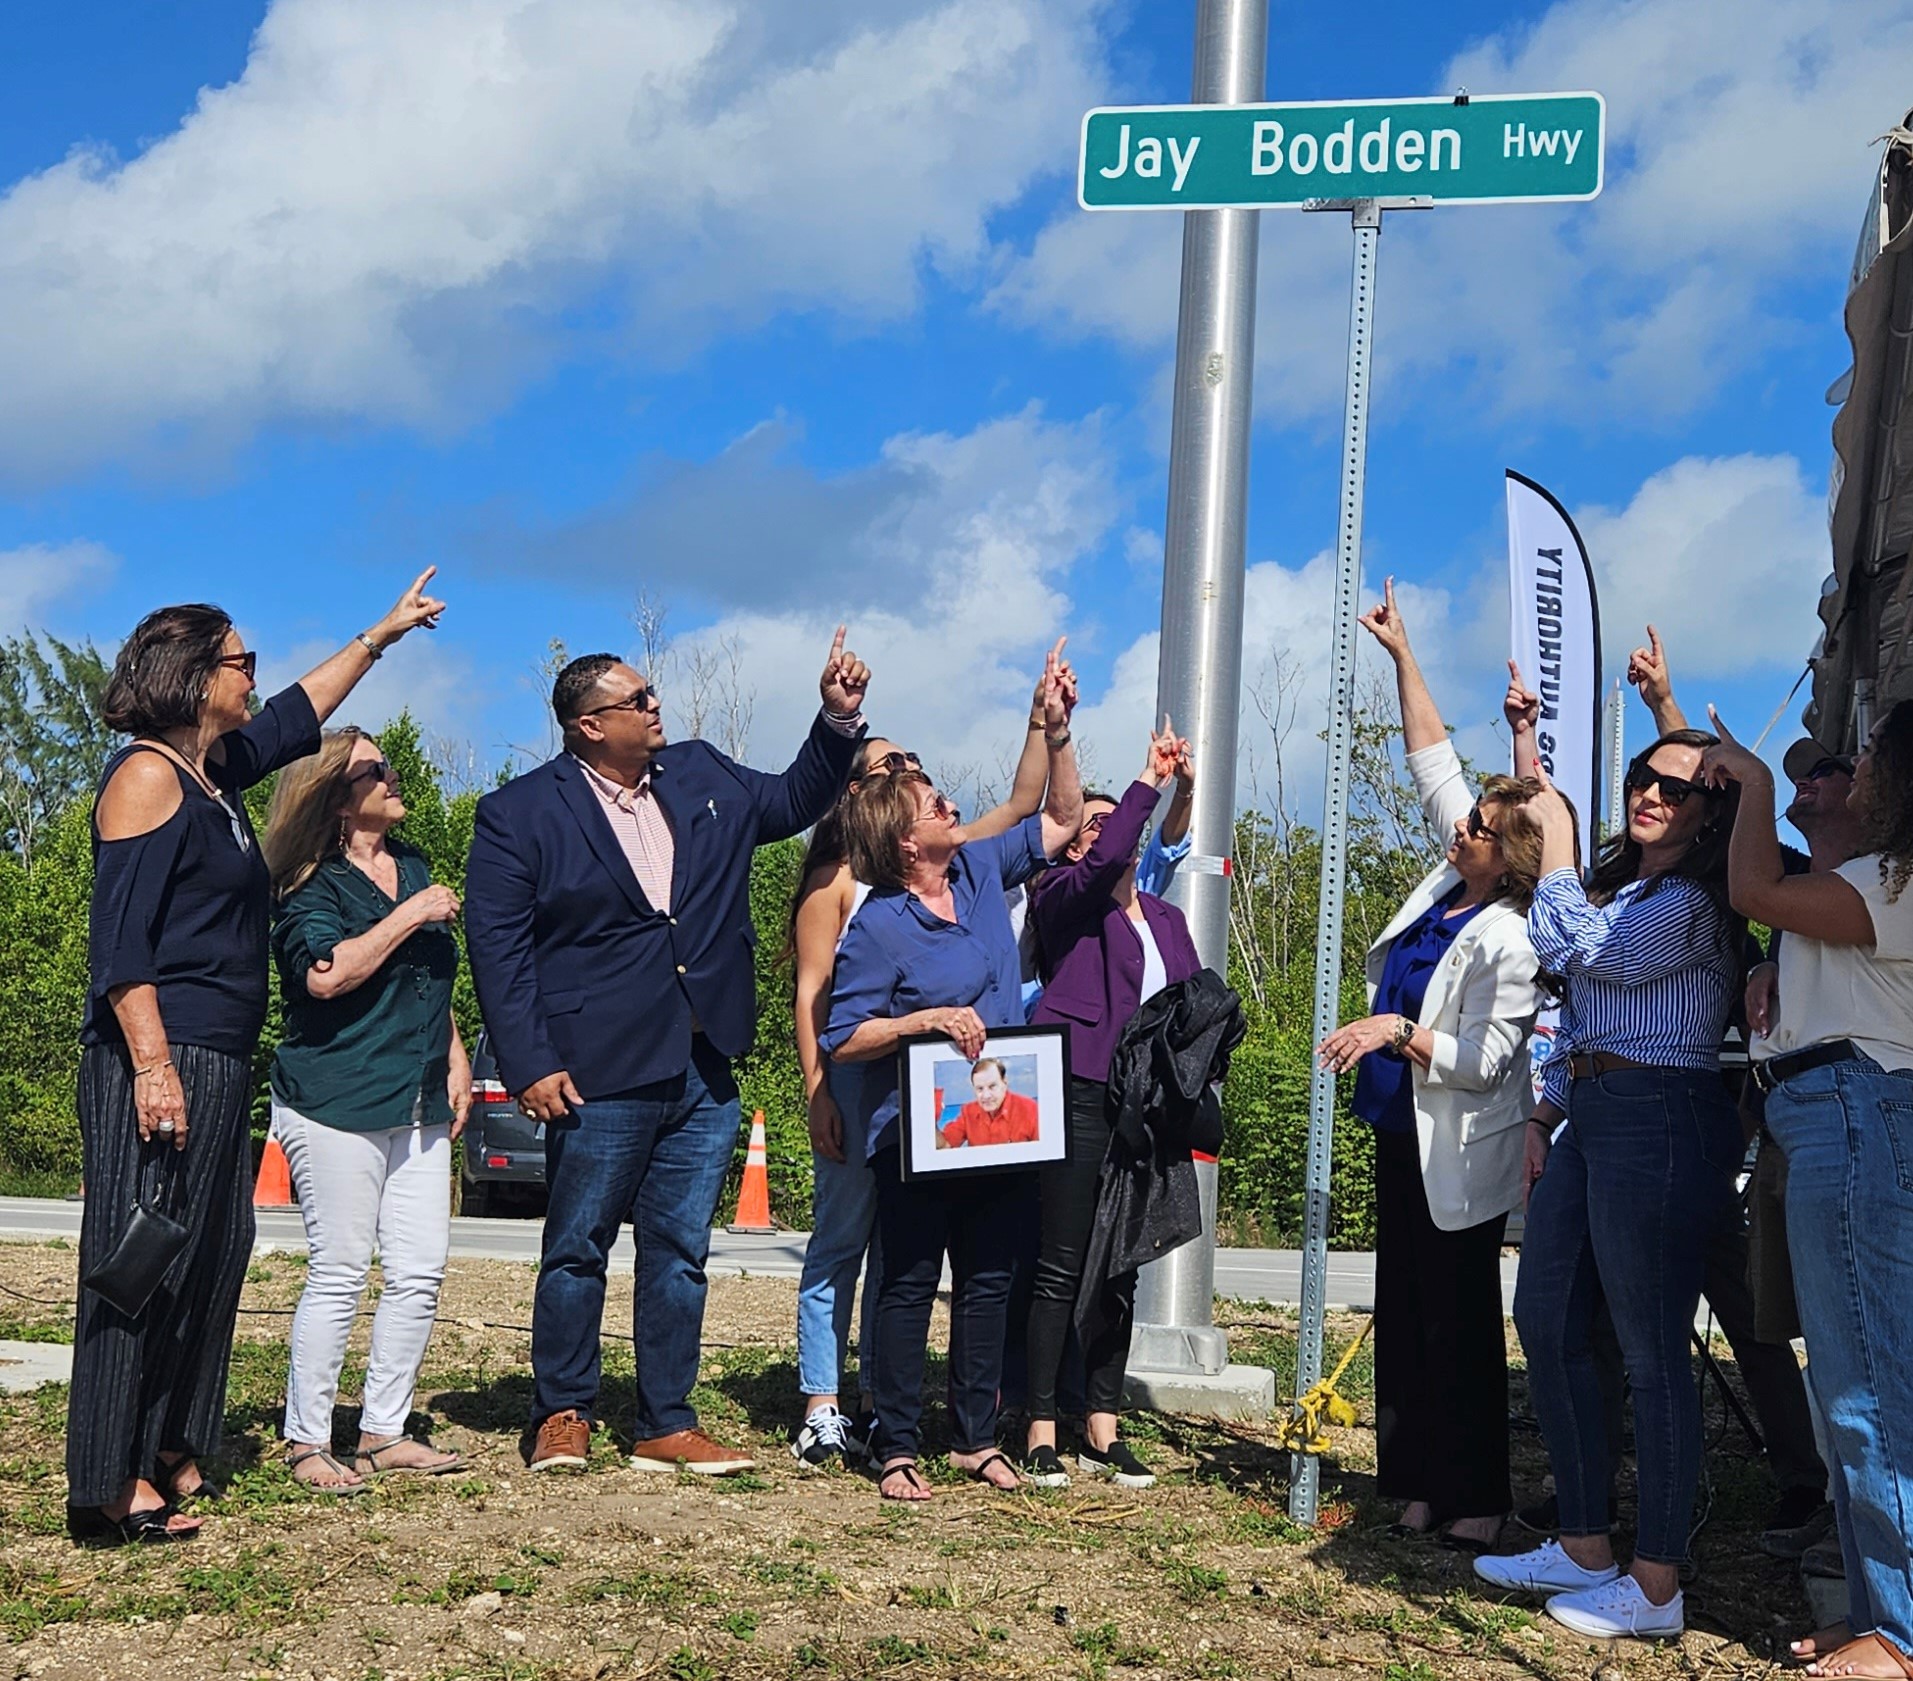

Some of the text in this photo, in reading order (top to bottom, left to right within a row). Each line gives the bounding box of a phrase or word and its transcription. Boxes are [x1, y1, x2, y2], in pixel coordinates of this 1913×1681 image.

[1100, 117, 1583, 191] Jay Bodden Hwy
